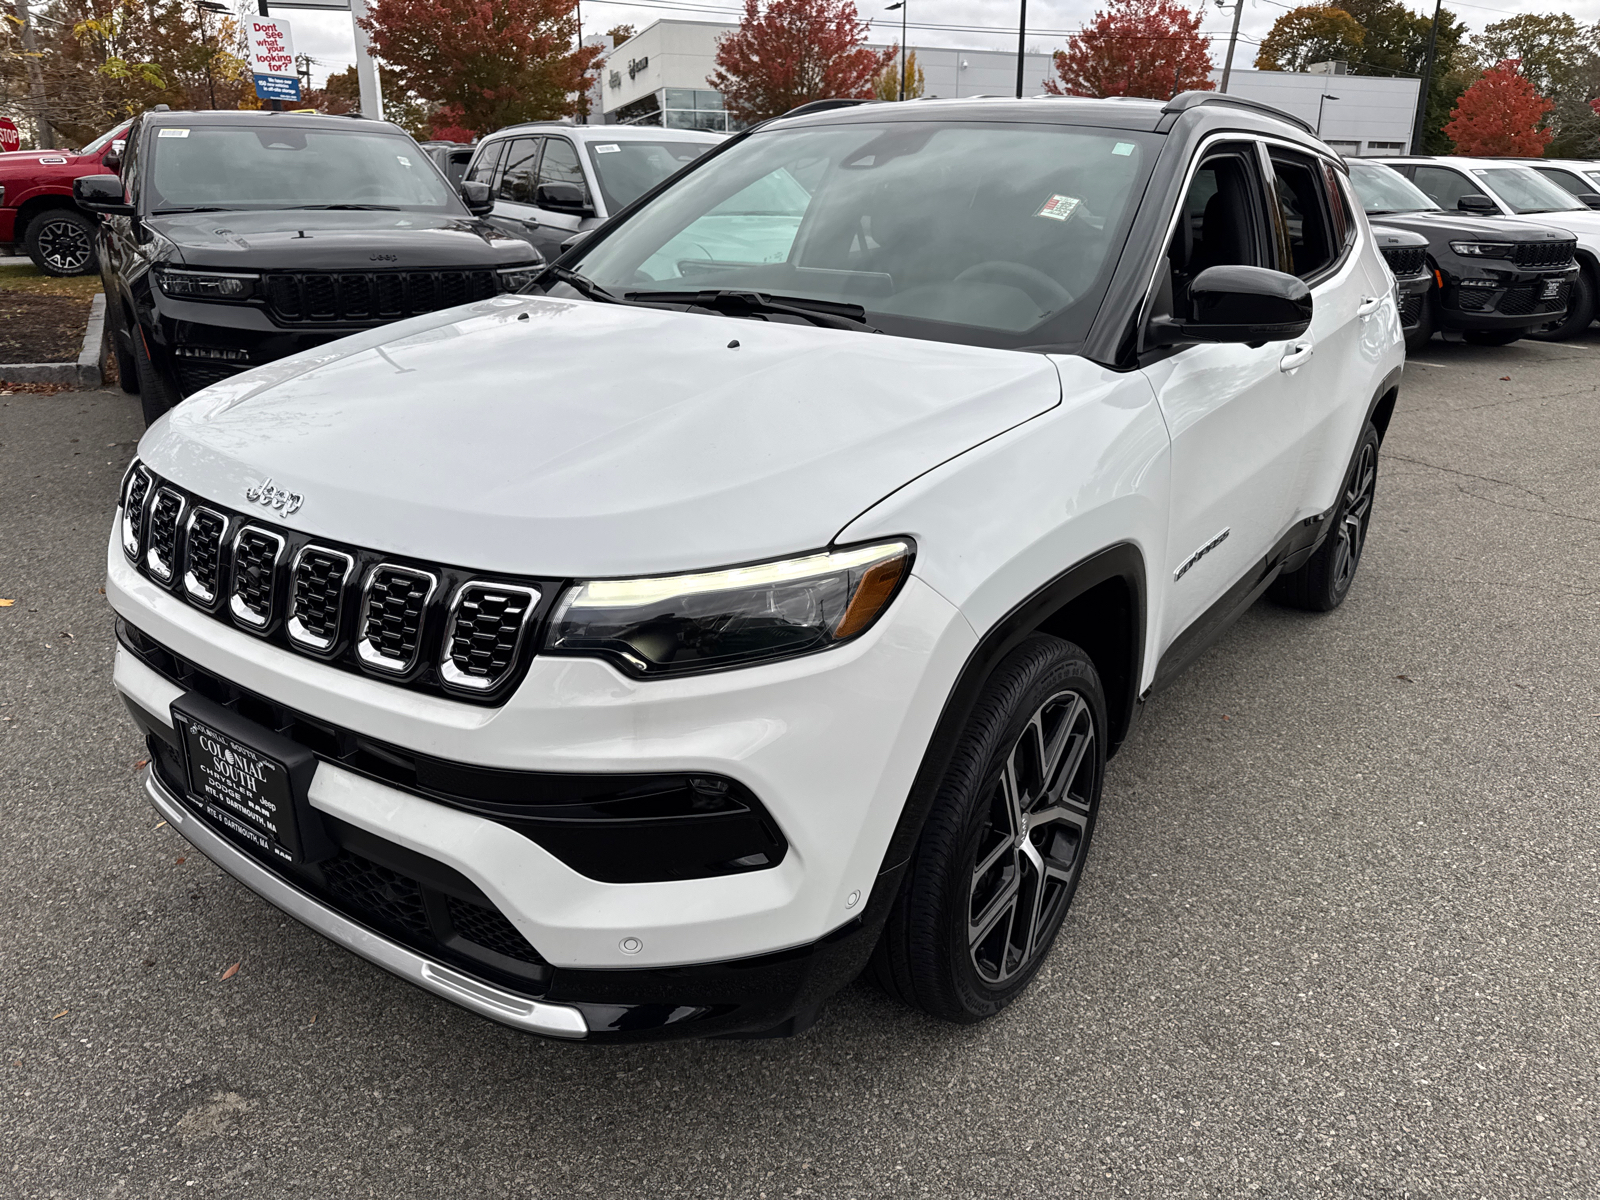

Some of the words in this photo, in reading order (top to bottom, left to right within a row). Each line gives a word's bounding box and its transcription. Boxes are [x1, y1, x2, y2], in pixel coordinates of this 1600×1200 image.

[253, 22, 278, 32] Dont
[265, 31, 283, 39] see
[256, 38, 279, 47] what
[266, 46, 285, 54] your
[256, 53, 292, 64] looking
[268, 62, 288, 72] for?
[0, 127, 18, 144] STOP
[369, 252, 398, 263] Jeep
[246, 477, 305, 519] Jeep
[199, 735, 267, 783] COLONIAL
[200, 764, 254, 799] CHRYSLER
[213, 756, 258, 793] SOUTH
[208, 777, 242, 801] DODGE
[204, 784, 219, 799] RTE.
[266, 820, 278, 833] MA
[248, 800, 271, 818] RAM
[259, 796, 277, 812] Jeep
[206, 806, 219, 820] RTE.
[259, 838, 270, 850] MA
[274, 848, 293, 862] RAM
